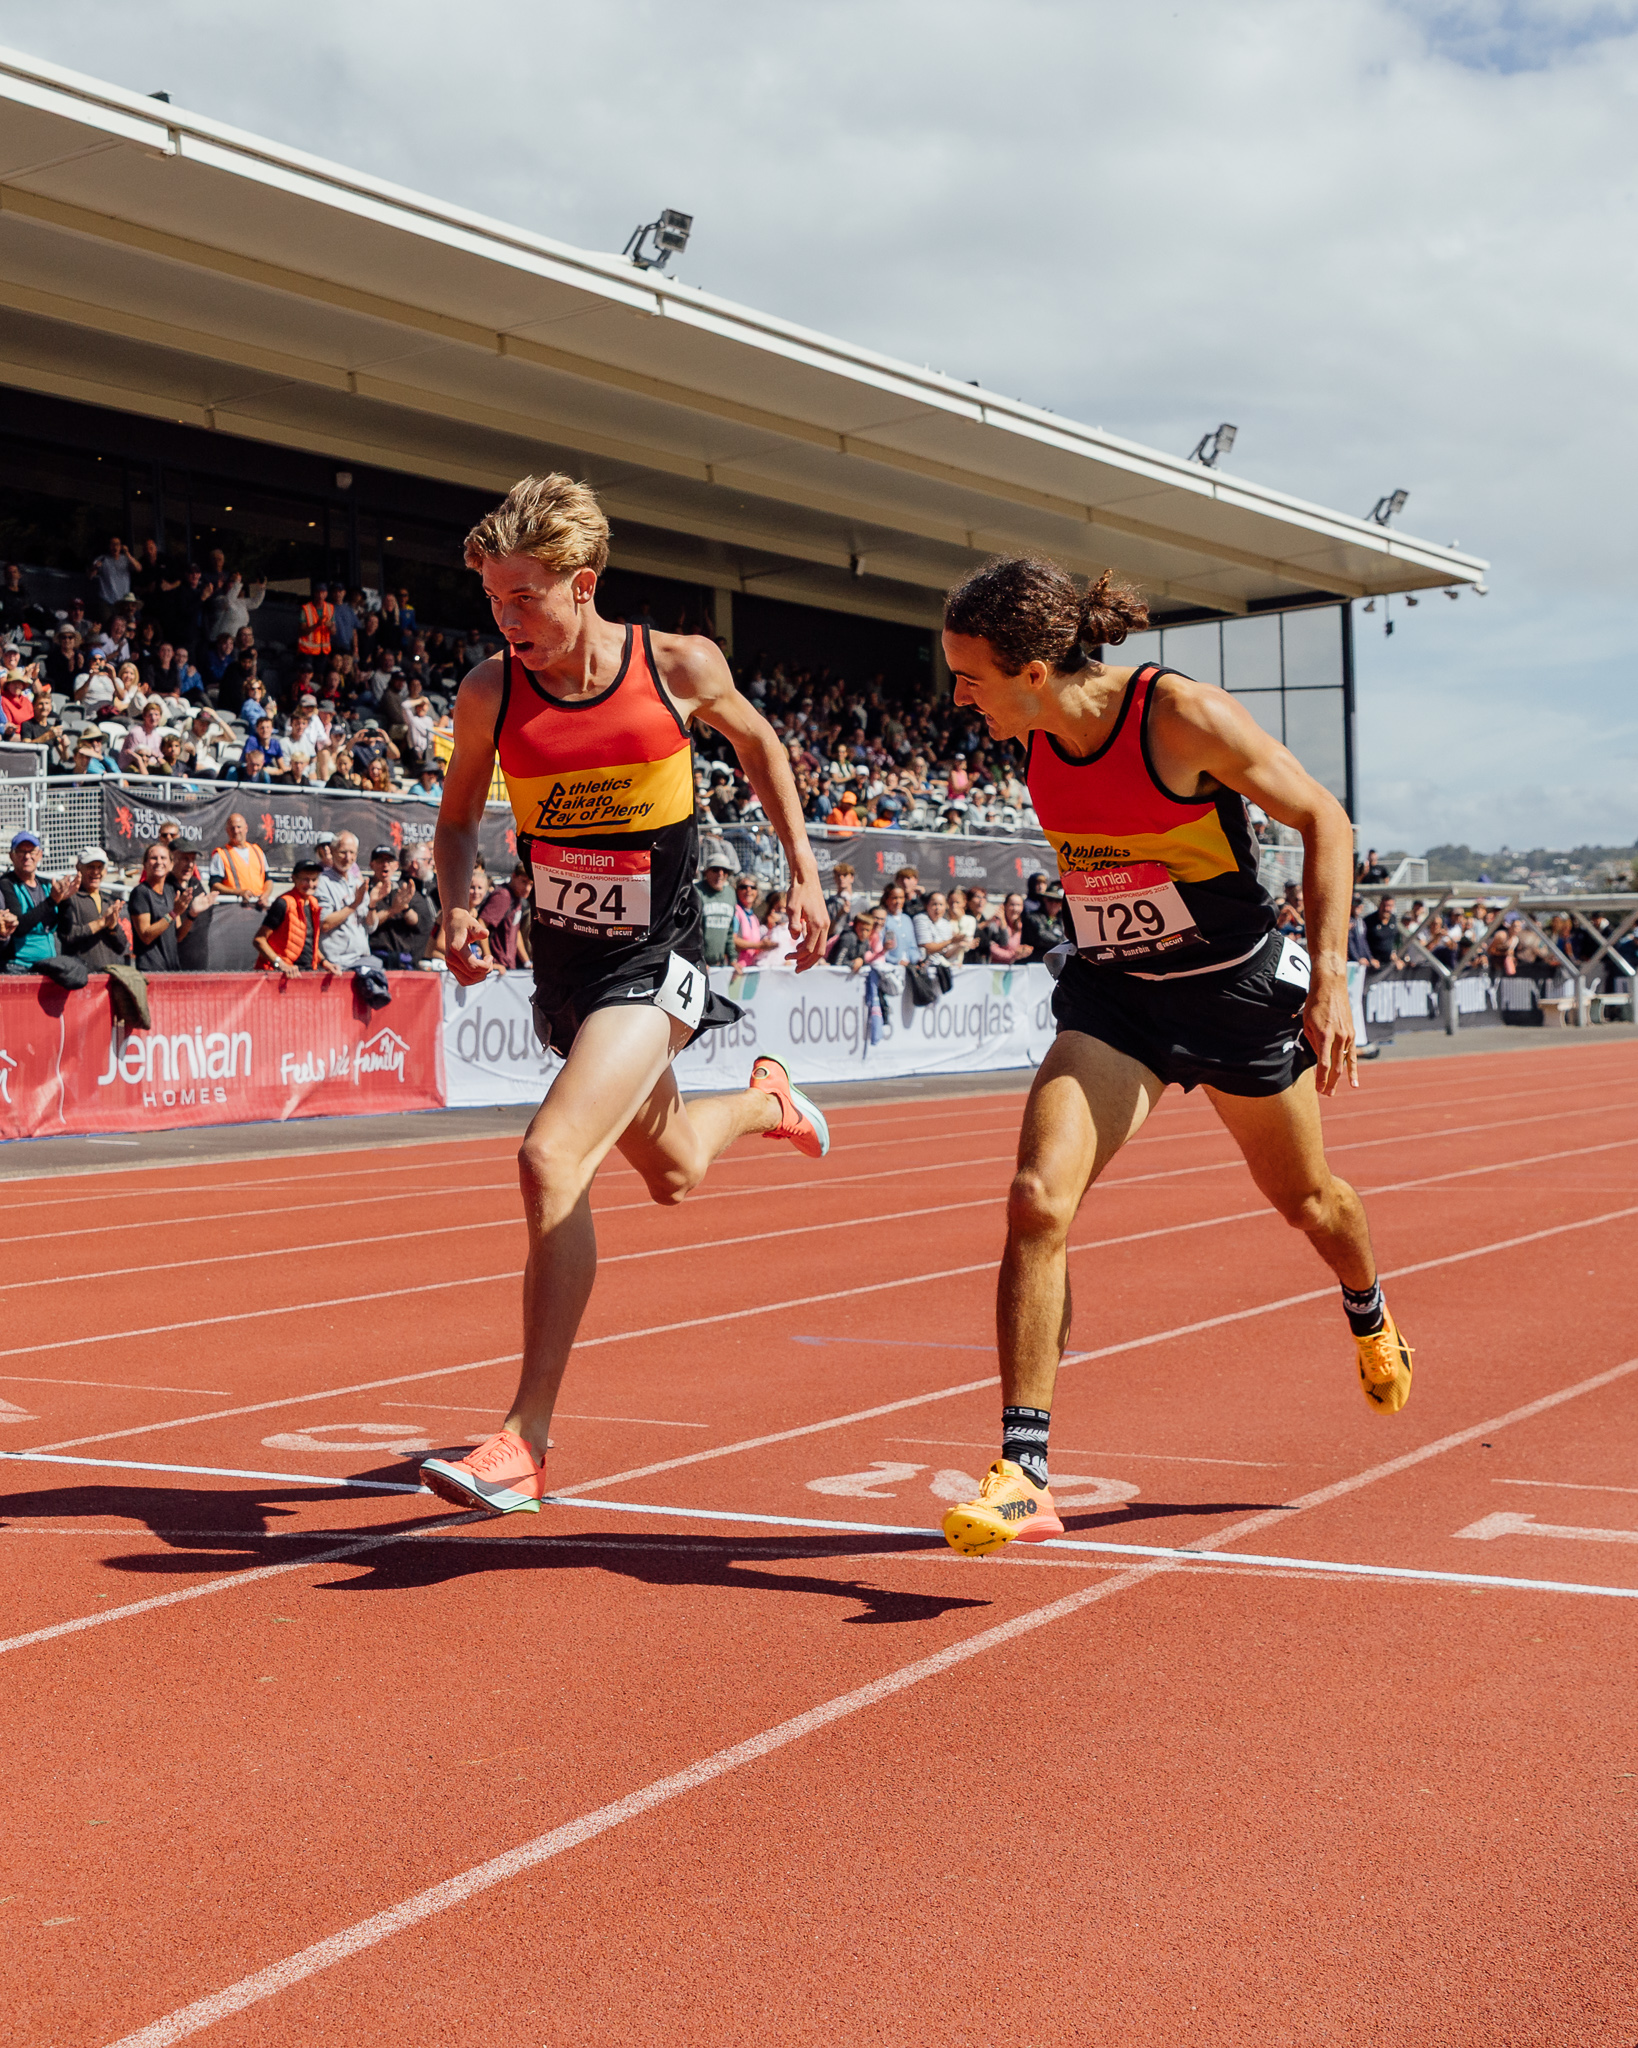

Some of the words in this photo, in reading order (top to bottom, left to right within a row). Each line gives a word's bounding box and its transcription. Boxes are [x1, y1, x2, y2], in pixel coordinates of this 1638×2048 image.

[551, 778, 632, 799] Athletics
[134, 808, 155, 823] THE
[580, 807, 600, 821] of
[600, 802, 655, 819] Plenty
[274, 815, 290, 830] THE
[291, 816, 313, 830] LION
[402, 822, 418, 835] THE
[134, 823, 203, 841] FOUTION
[275, 830, 322, 845] FOUNDATI
[1060, 841, 1131, 858] Athletics
[560, 850, 615, 868] Jennian
[543, 867, 560, 875] TRACK
[565, 871, 580, 879] FIELD
[581, 874, 630, 883] CHAMPIONSHIPS
[1083, 871, 1133, 889] Jennian
[548, 876, 627, 921] 724
[573, 922, 599, 935] dunedin
[1084, 900, 1166, 942] 729
[606, 927, 633, 937] CIRCUIT
[676, 969, 694, 1011] 4
[922, 993, 1014, 1049] douglas
[97, 1025, 252, 1085] Jennian
[280, 1050, 325, 1085] Feels
[353, 1034, 405, 1086] family
[142, 1087, 228, 1108] HOMES
[1000, 1498, 1037, 1521] NITRO
